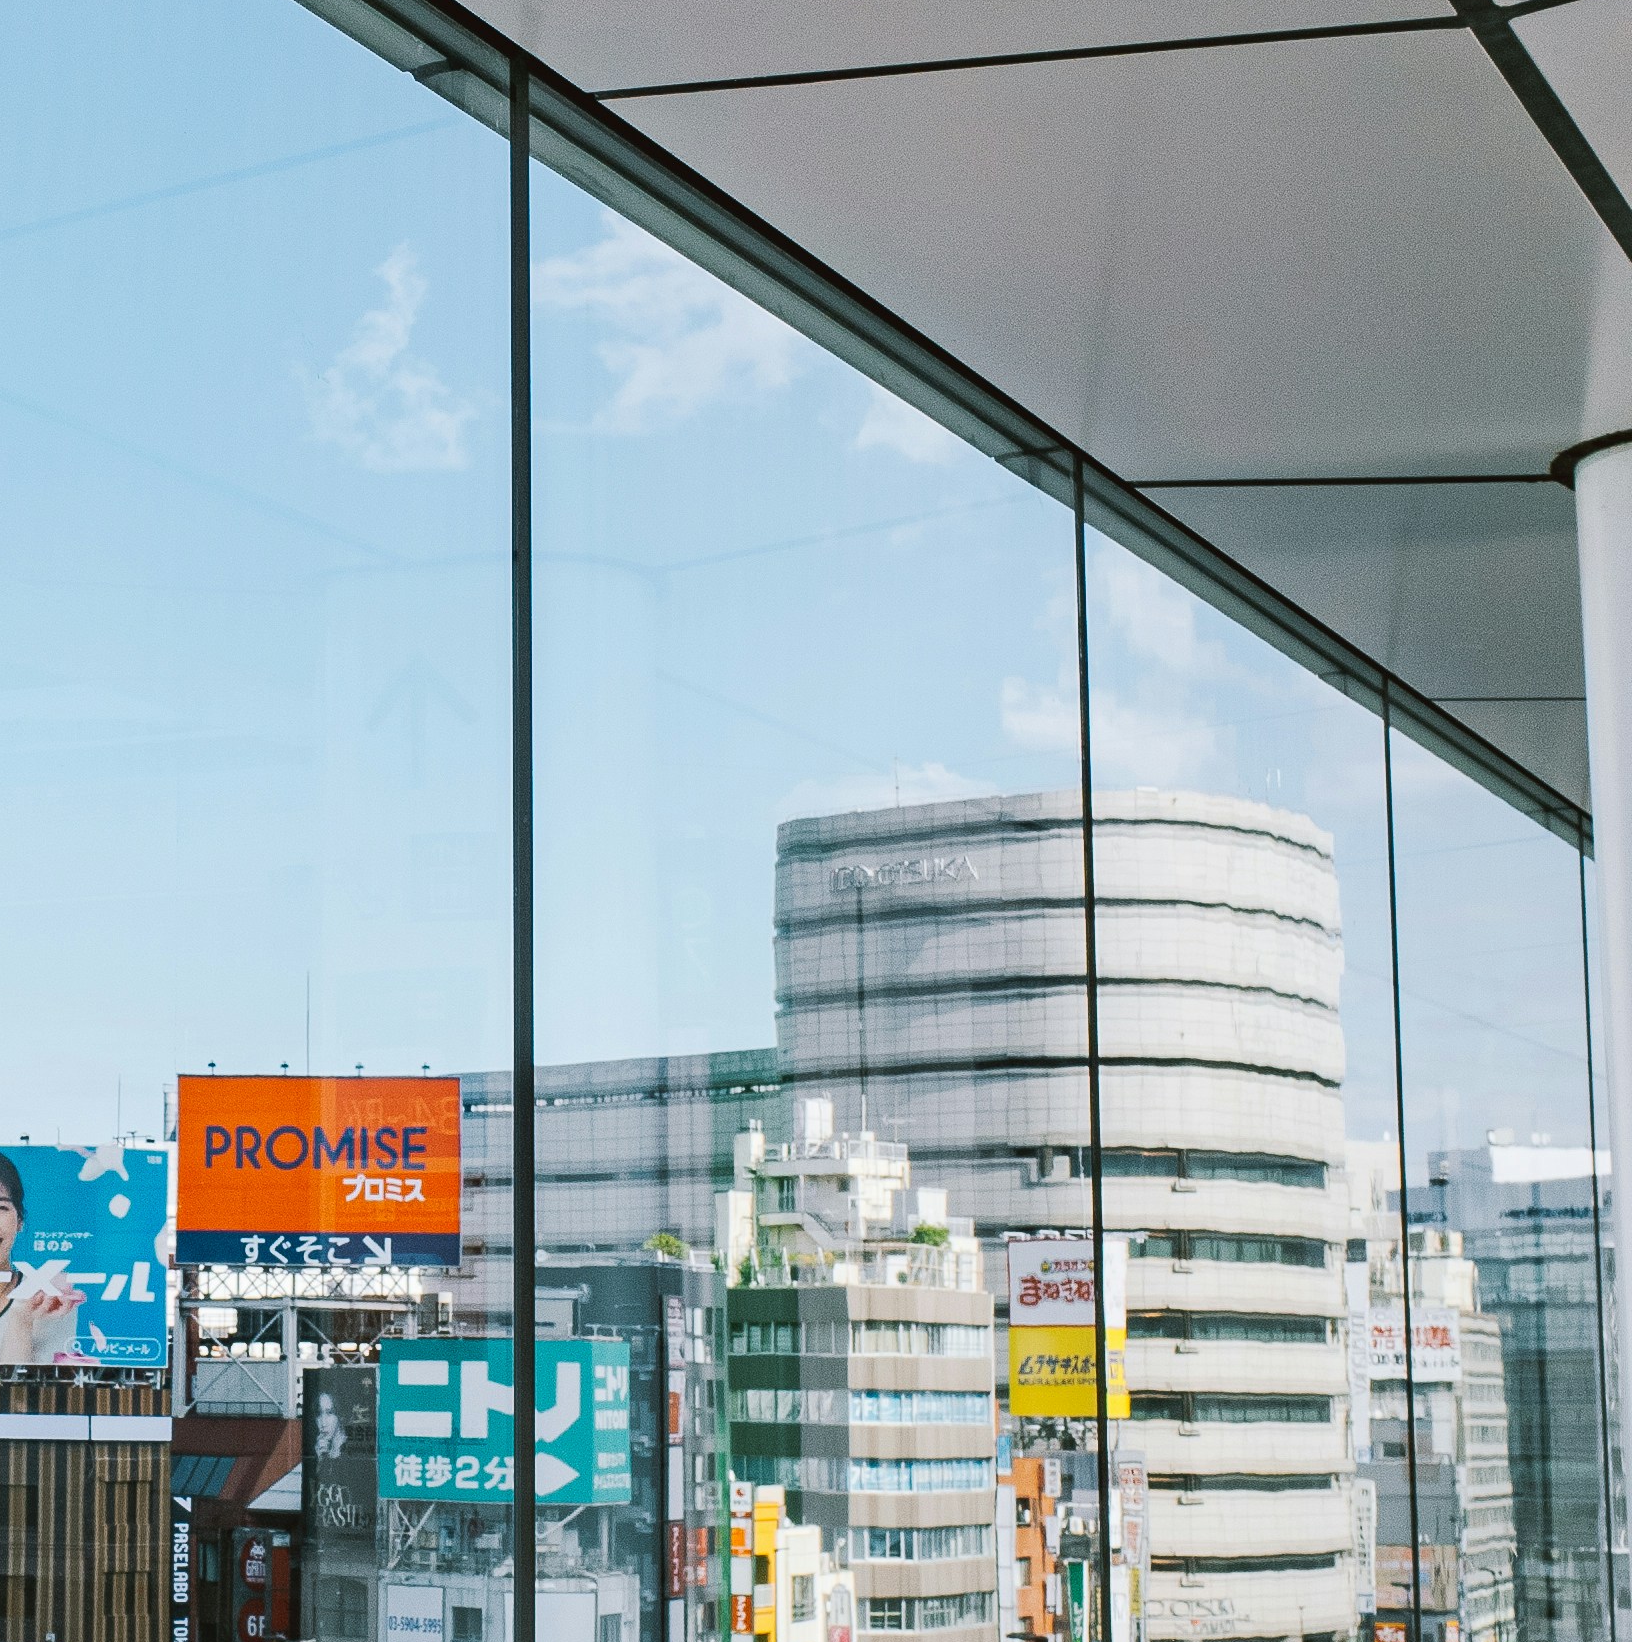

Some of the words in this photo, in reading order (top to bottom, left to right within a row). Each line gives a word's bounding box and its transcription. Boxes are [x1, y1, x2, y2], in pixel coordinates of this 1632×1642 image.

[204, 1125, 428, 1171] PROMISE
[342, 1173, 426, 1203] プロミス
[240, 1234, 351, 1265] すぐそこ
[1019, 1275, 1096, 1306] まねきね
[394, 1360, 581, 1443] ニトリ
[394, 1454, 515, 1491] 徒歩2分
[172, 1522, 189, 1604] PASELABO
